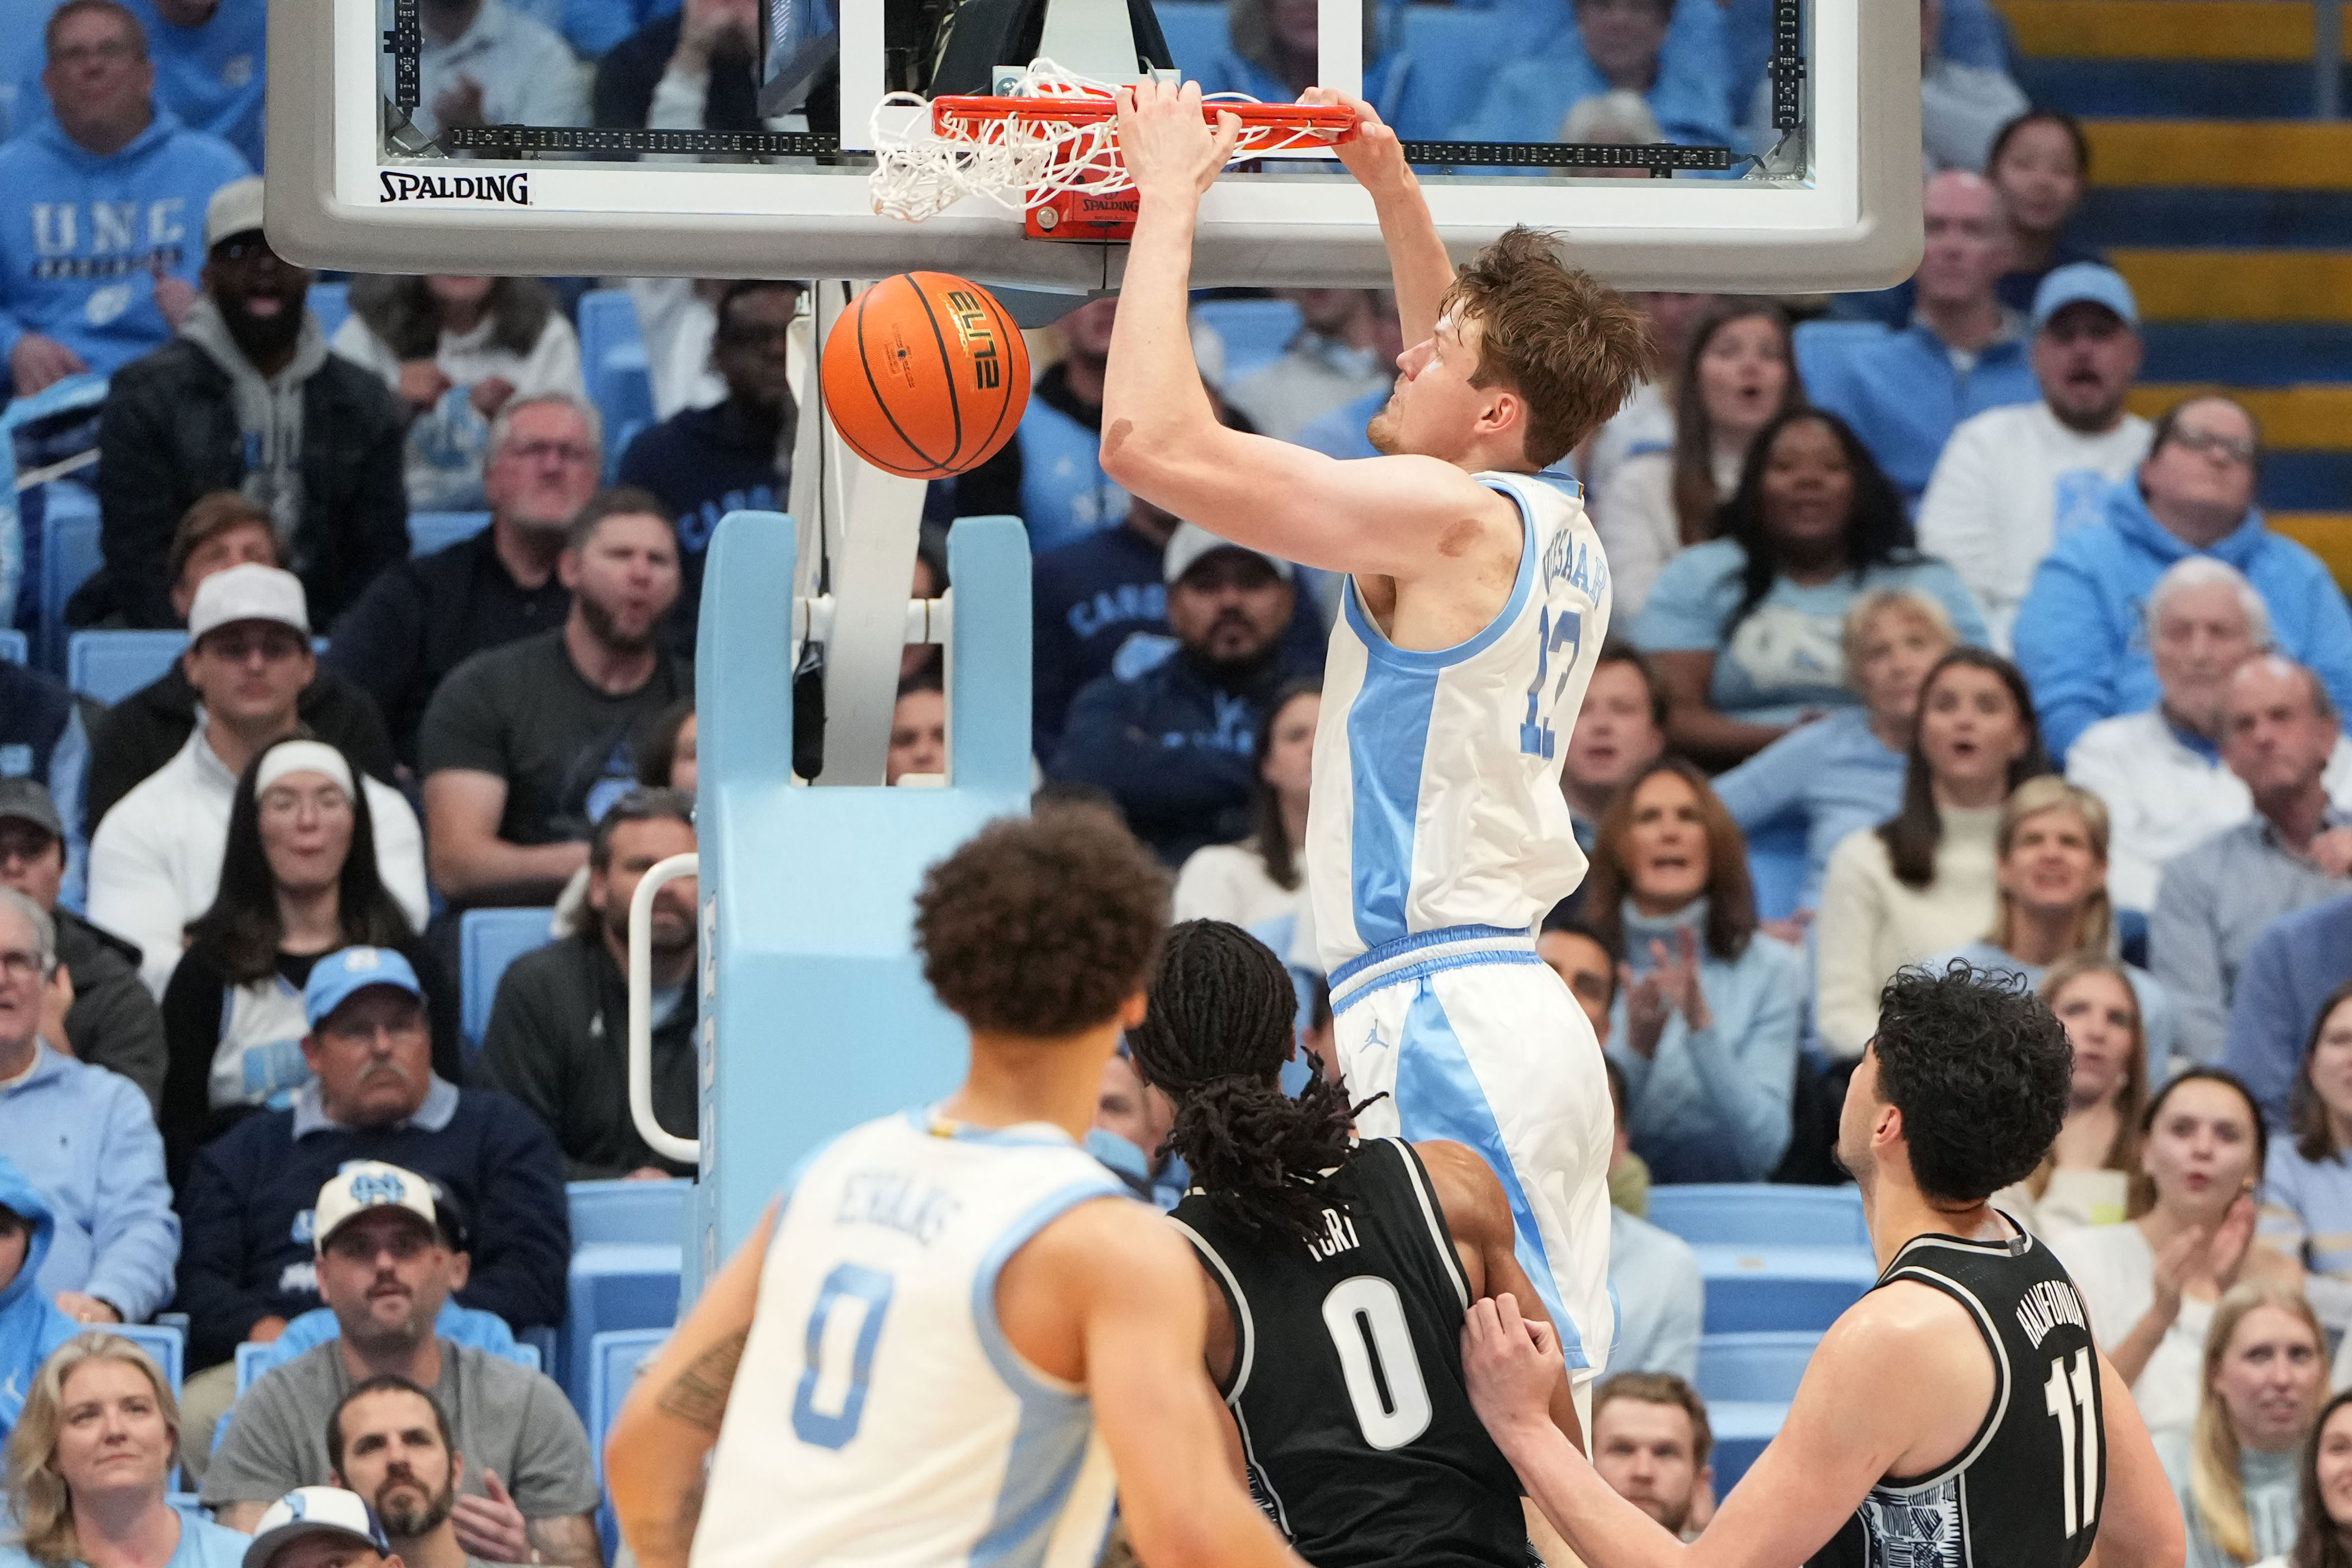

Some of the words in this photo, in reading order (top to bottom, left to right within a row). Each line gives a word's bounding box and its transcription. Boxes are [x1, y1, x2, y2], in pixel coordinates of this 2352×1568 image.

[32, 199, 186, 255] UNC
[380, 170, 527, 205] SPALDING
[1083, 198, 1139, 212] SPALDING
[947, 291, 1000, 391] ELITE
[791, 1261, 895, 1451] 0
[1322, 1275, 1432, 1451] 0
[2044, 1346, 2098, 1539] 11
